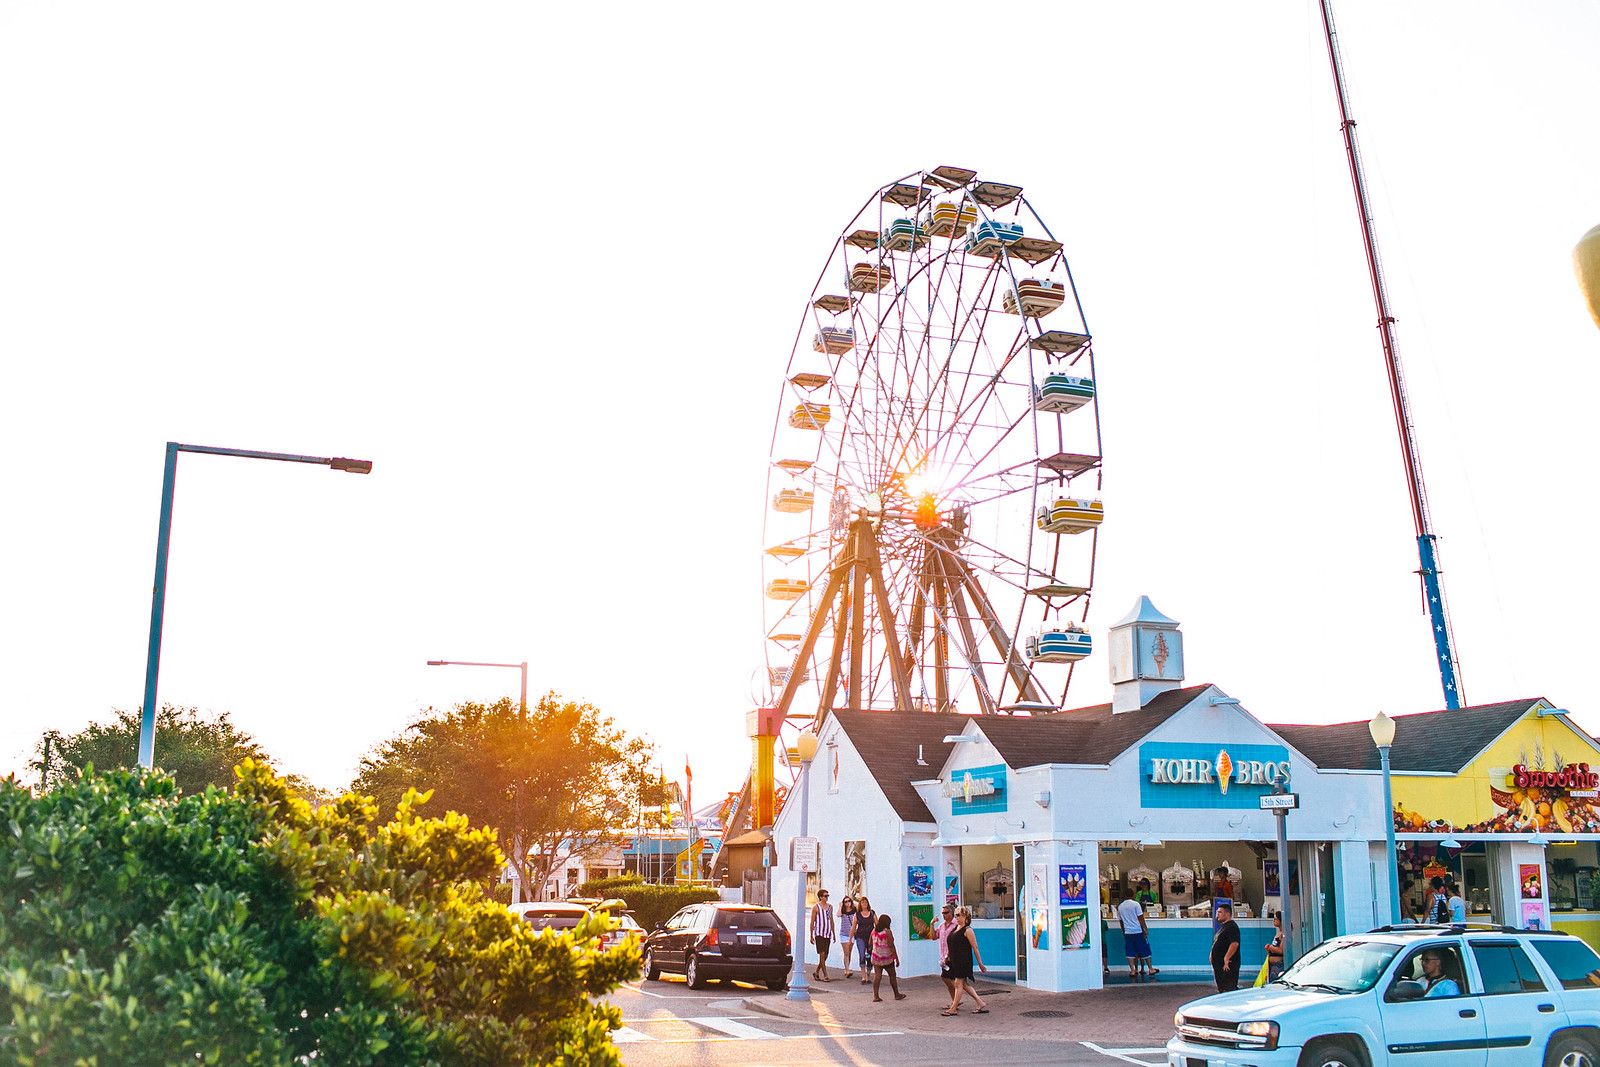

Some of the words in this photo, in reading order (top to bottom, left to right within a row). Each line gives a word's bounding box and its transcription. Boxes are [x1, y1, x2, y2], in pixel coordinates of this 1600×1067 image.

[1151, 758, 1215, 784] KOHR
[1235, 760, 1292, 786] BROS
[1513, 762, 1599, 789] Smoothie
[1261, 797, 1274, 807] 15th
[1275, 797, 1294, 807] Street
